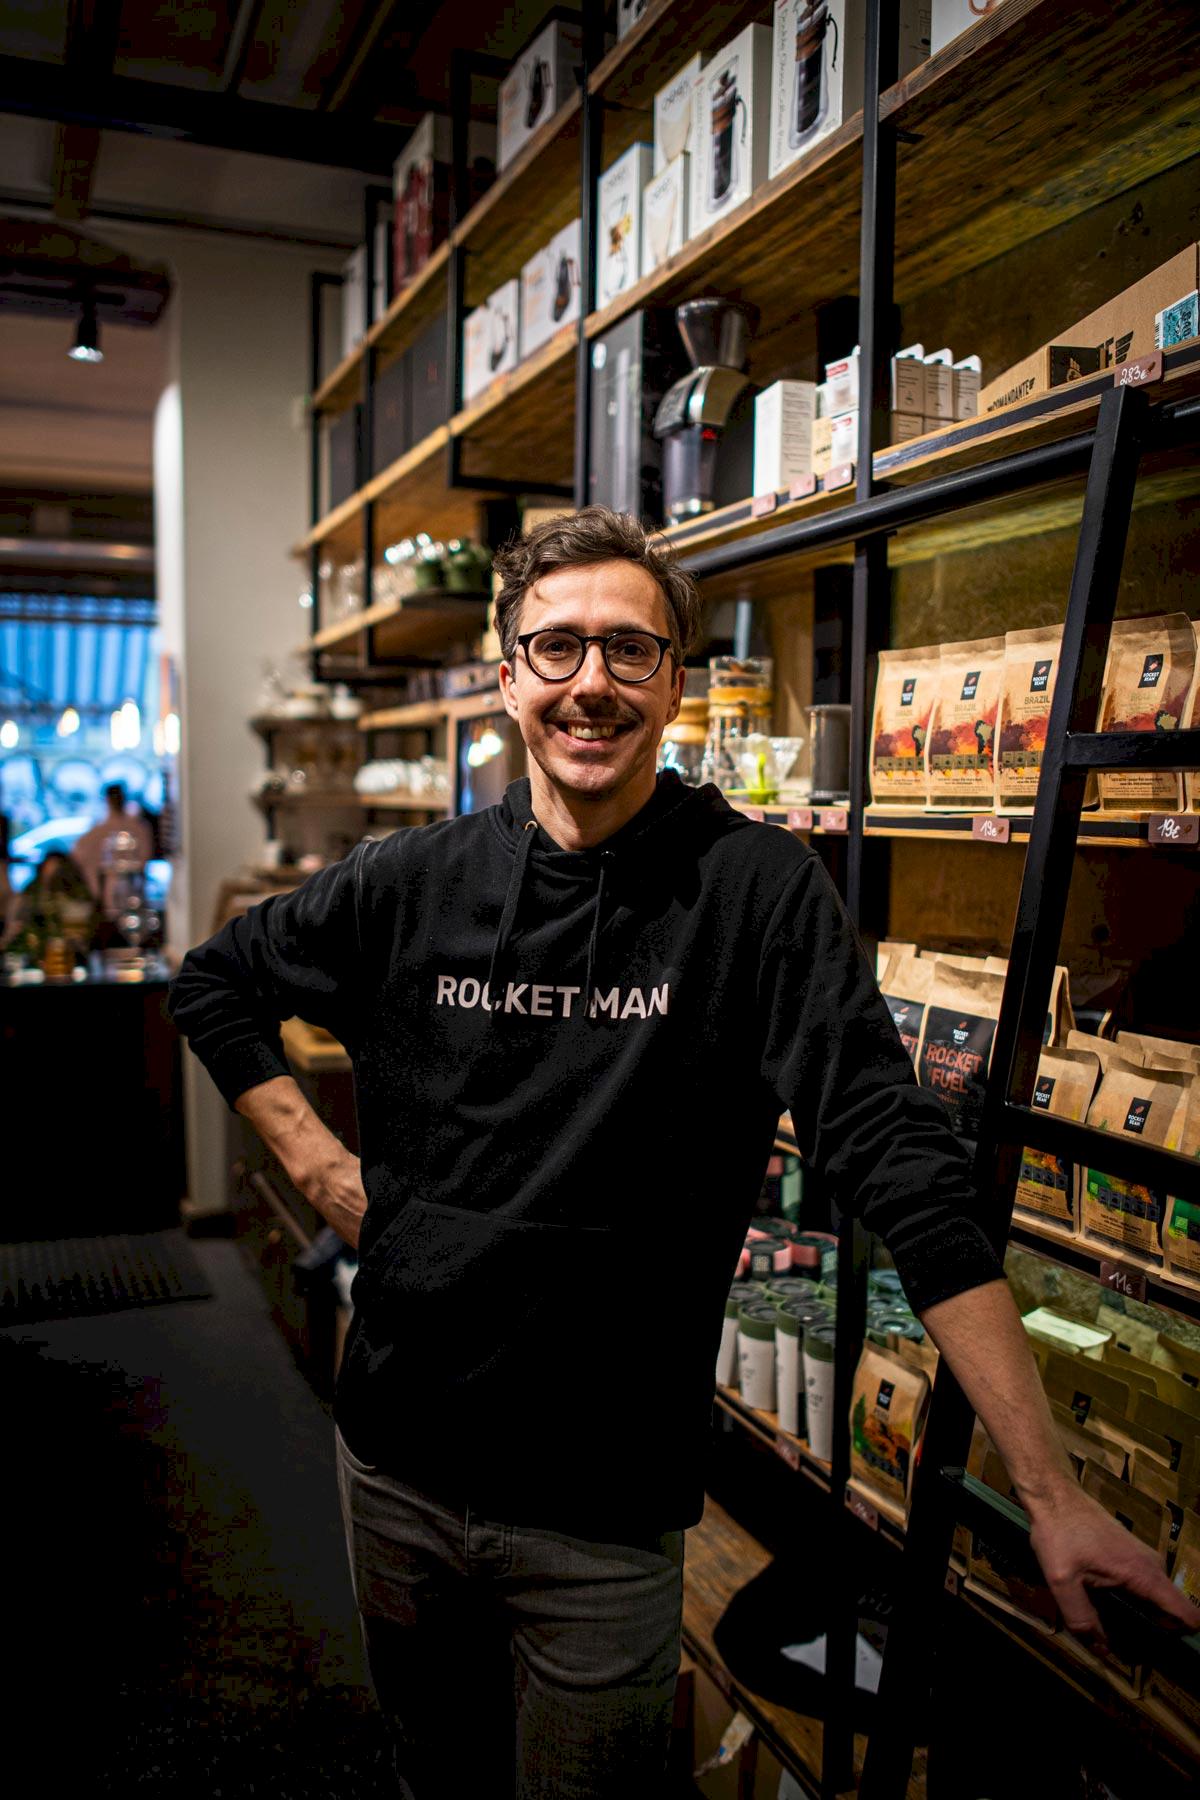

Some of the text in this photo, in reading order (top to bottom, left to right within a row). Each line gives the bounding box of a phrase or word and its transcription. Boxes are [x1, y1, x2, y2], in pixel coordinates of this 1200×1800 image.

[1120, 365, 1148, 386] 283€
[1024, 695, 1050, 705] BRAZIL
[980, 820, 997, 837] 19€
[1157, 818, 1180, 839] 19€
[589, 983, 669, 1020] MAN
[925, 1042, 983, 1073] ROCKET
[929, 1067, 969, 1094] FUEL
[1108, 1271, 1133, 1295] 11€
